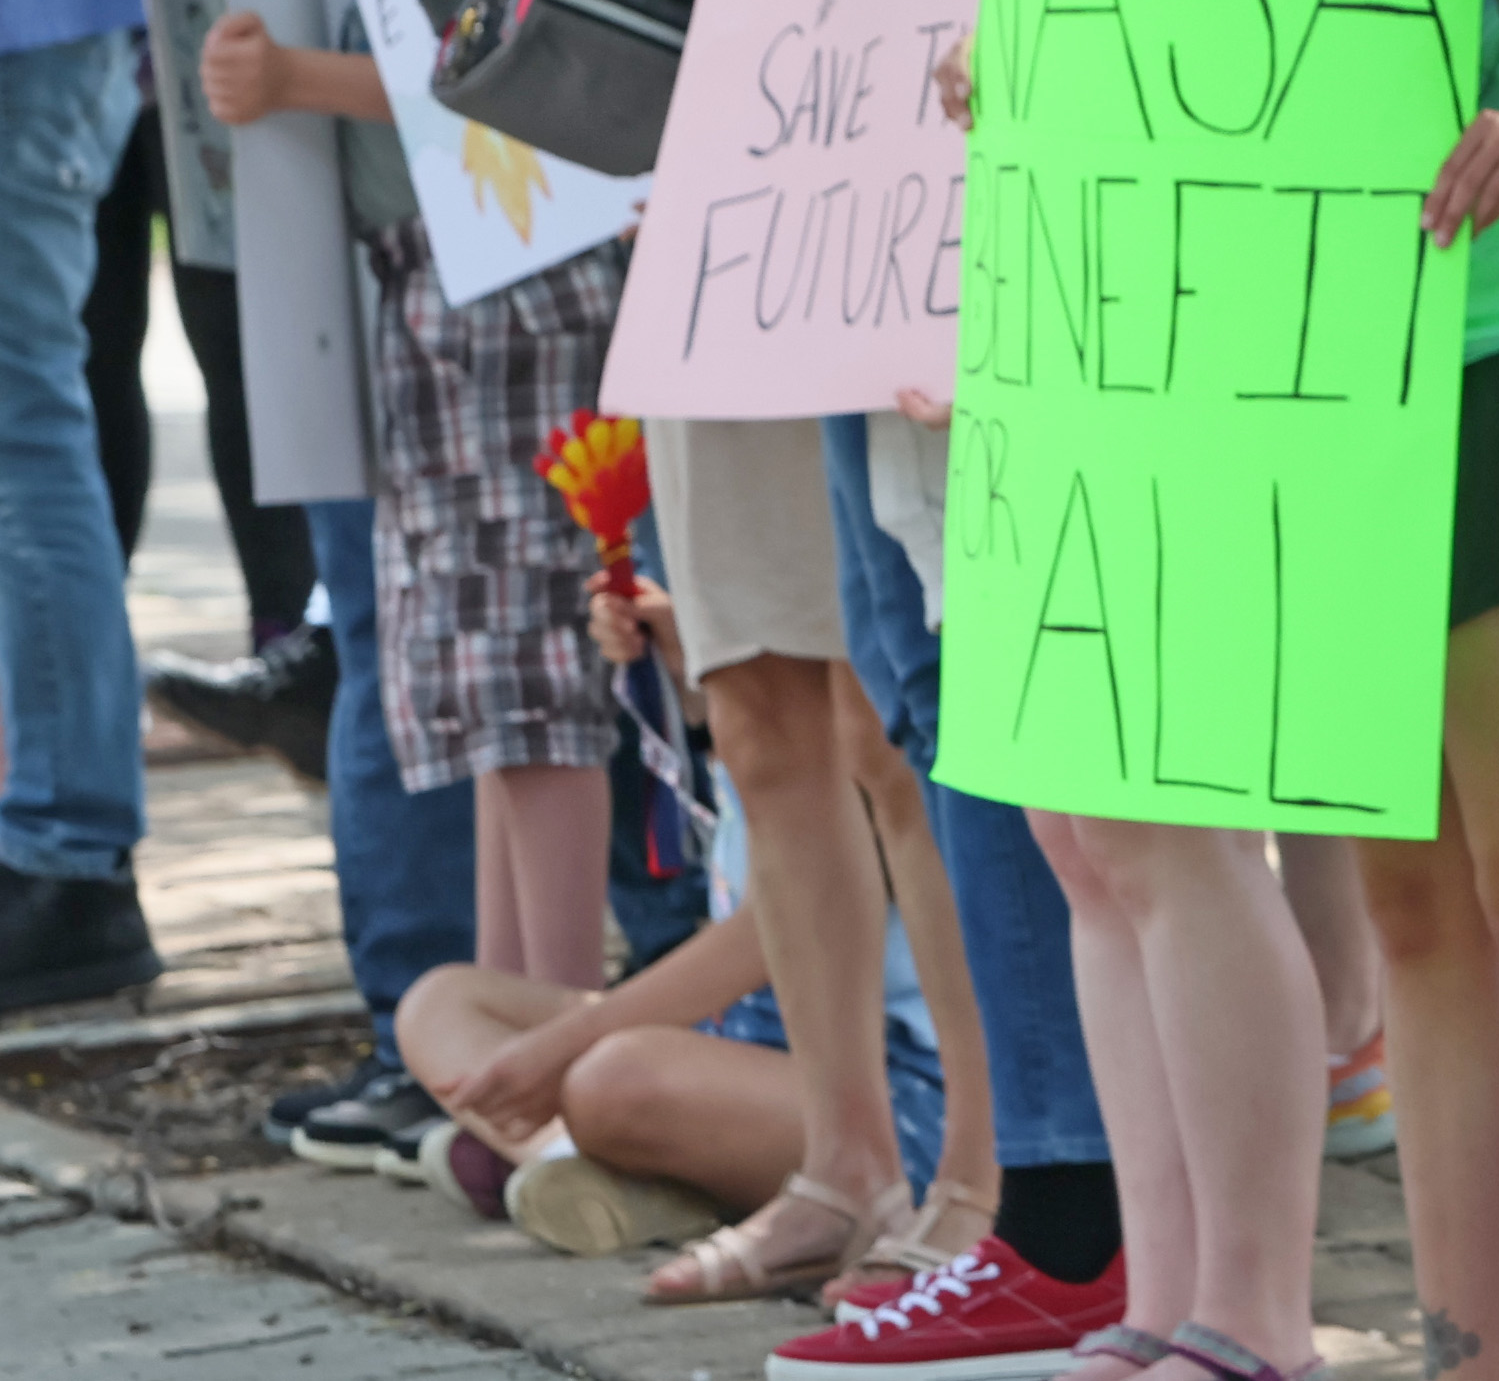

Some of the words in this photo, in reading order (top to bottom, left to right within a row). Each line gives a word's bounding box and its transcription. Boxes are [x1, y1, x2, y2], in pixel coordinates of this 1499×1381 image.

[747, 22, 886, 160] SAVE
[681, 170, 967, 362] FUTURE
[961, 152, 1430, 406] BENEFIT
[1012, 470, 1388, 815] ALL
